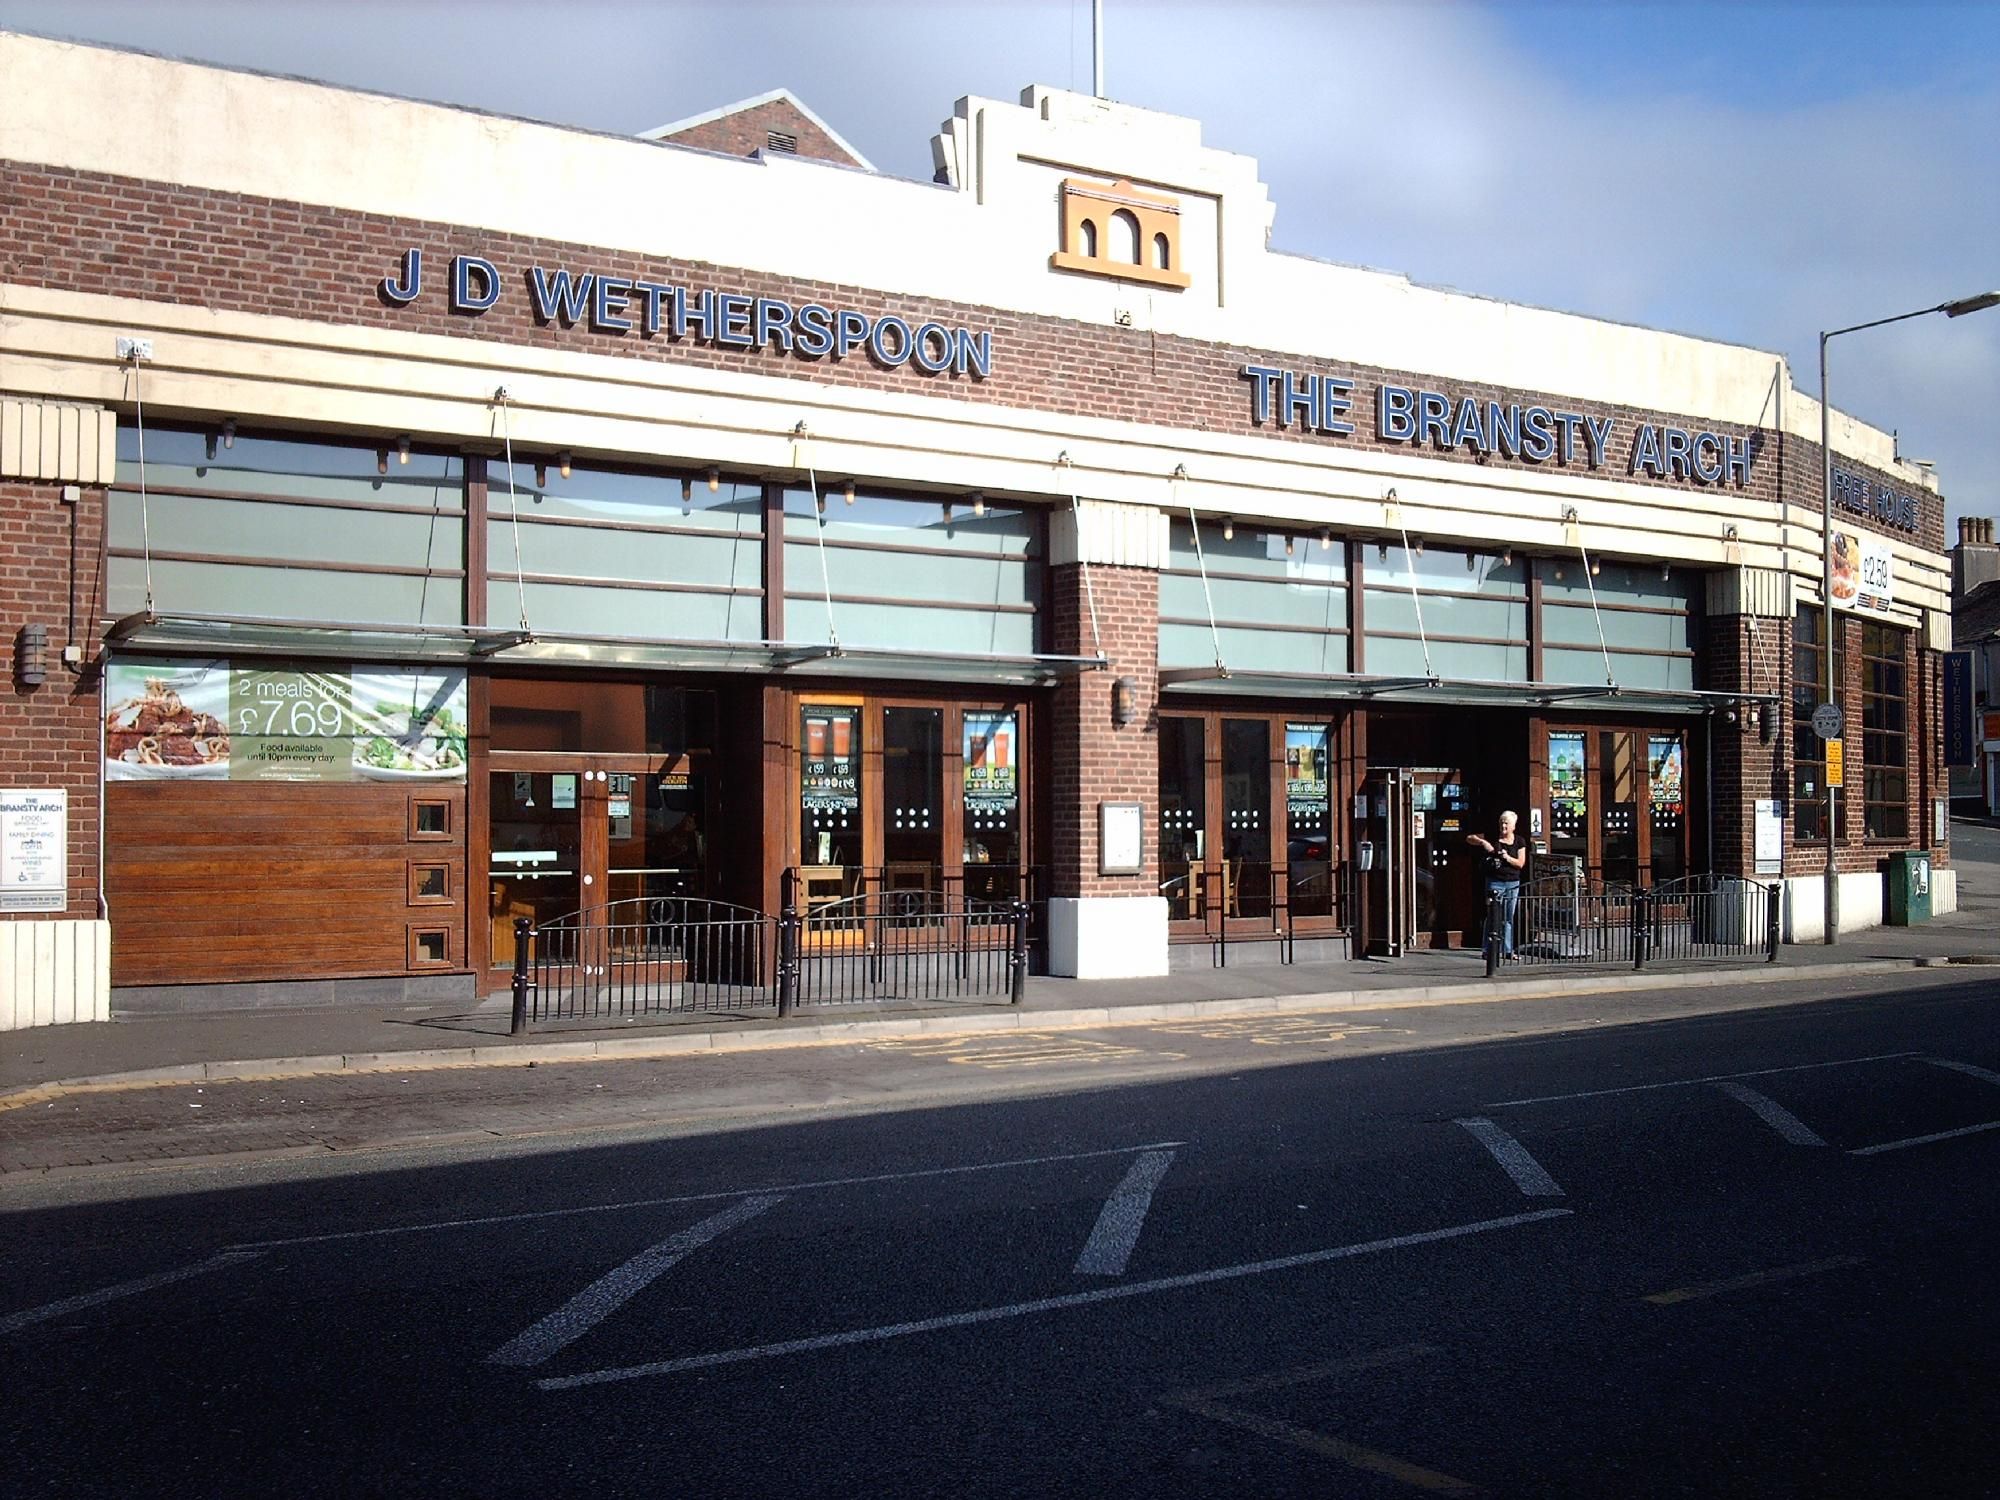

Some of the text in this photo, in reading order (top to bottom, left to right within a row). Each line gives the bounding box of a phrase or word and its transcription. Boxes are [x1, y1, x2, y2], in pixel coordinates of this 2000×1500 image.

[384, 248, 991, 377] J D WETHERSPOON
[1244, 364, 1751, 486] THE BRANSTY ARCH
[1832, 467, 1920, 532] FREE HOUSE
[1863, 556, 1888, 589] £2.59
[239, 678, 343, 698] 2 meals for
[239, 700, 343, 738] £7.69
[1951, 658, 1962, 759] WETHERSPOON
[246, 752, 337, 764] until 10pm every day.
[260, 743, 324, 753] Food available
[0, 804, 63, 812] BRANSTY ARCH
